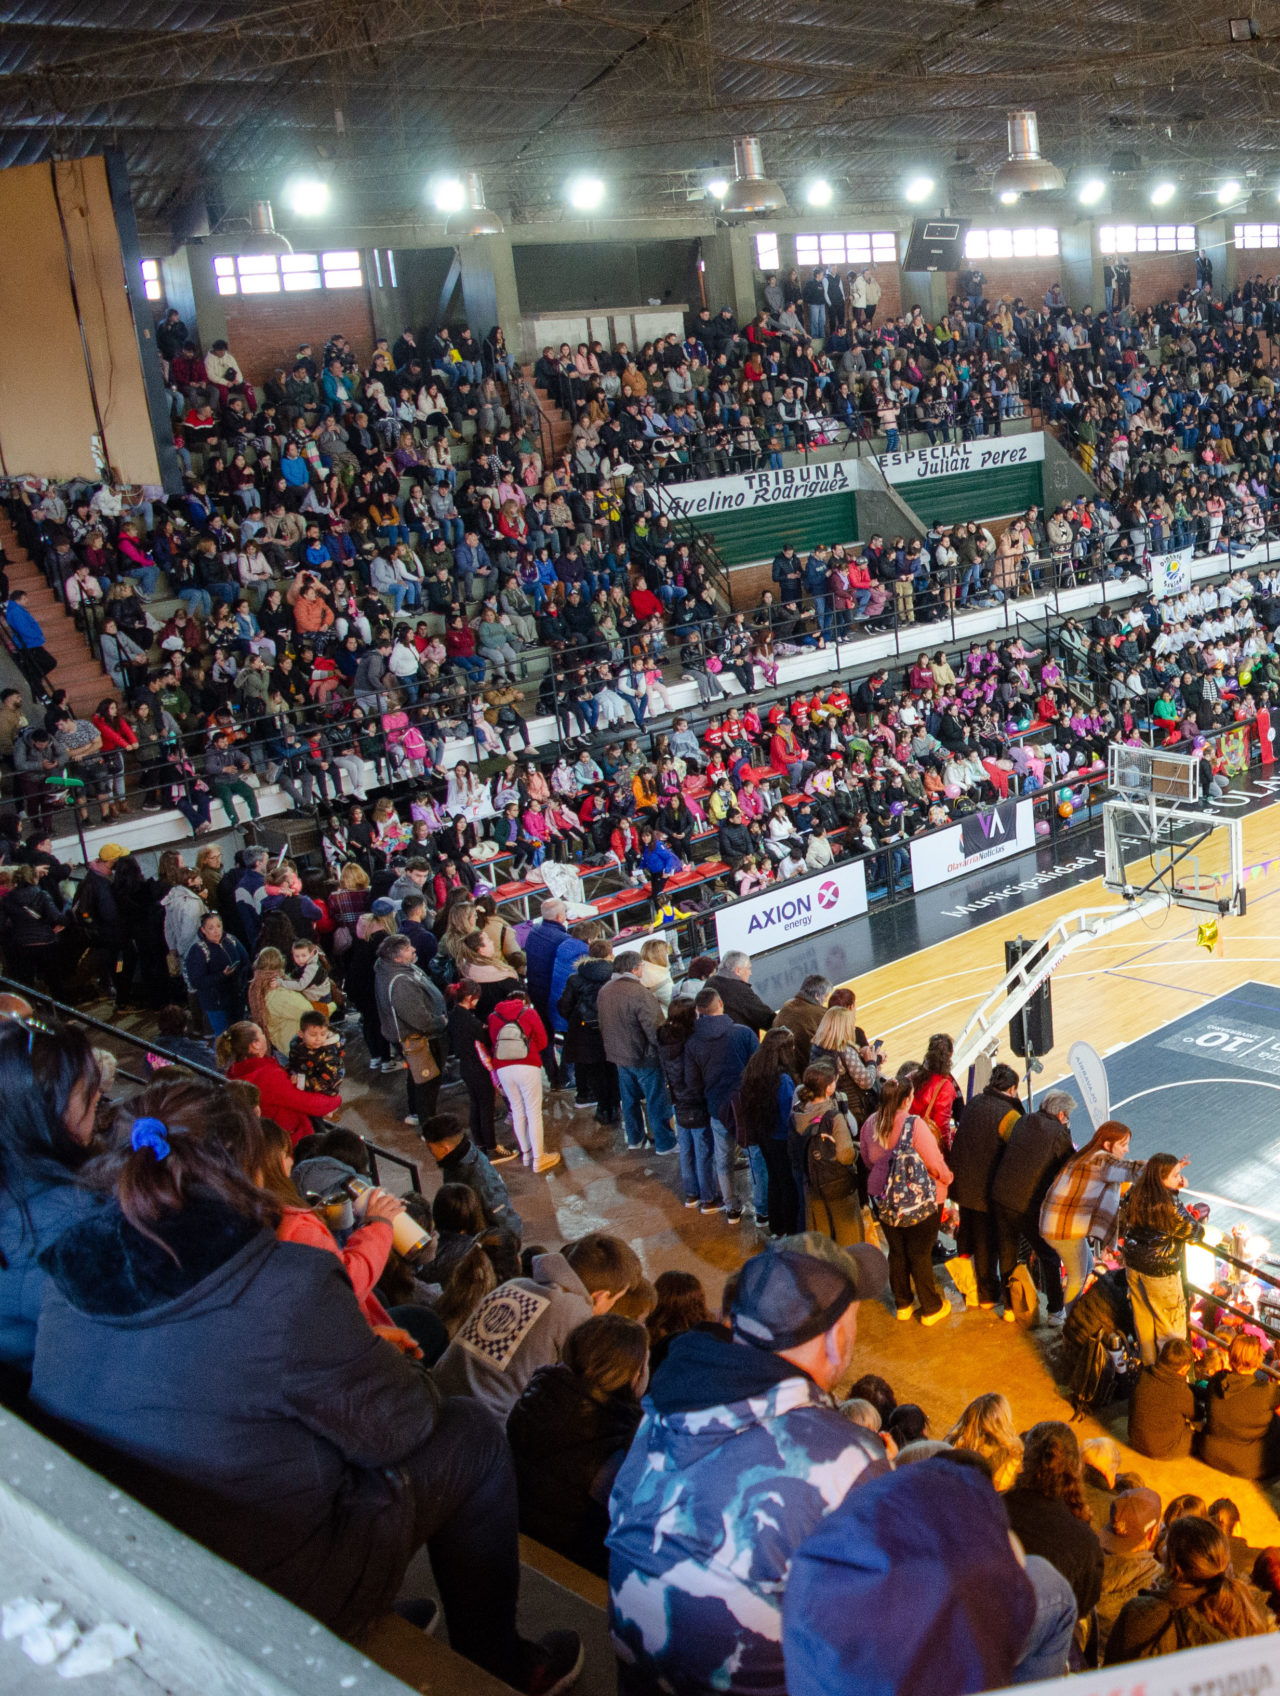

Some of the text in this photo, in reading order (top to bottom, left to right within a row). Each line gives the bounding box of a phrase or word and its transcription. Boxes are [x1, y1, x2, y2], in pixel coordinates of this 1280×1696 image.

[879, 443, 972, 467] ESPECIAL
[745, 462, 845, 489] TRIBUNA
[941, 856, 1097, 919] Municipalidad
[747, 894, 812, 934] AXION
[783, 914, 813, 932] energy
